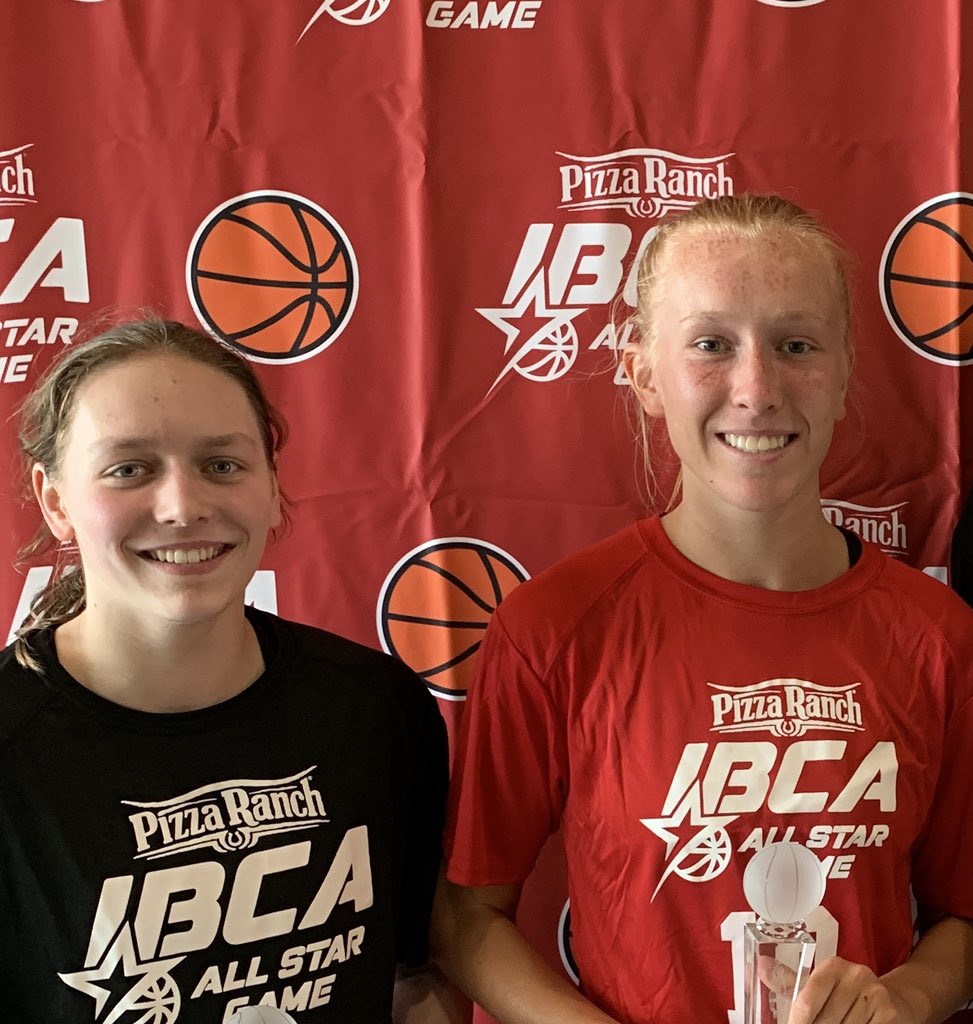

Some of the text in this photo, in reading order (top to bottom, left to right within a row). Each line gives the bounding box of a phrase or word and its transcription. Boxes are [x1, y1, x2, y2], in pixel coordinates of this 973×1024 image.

[425, 1, 542, 29] GAME
[560, 157, 734, 203] Pizza Ranch
[502, 223, 662, 307] IB
[0, 317, 79, 347] TAR
[588, 323, 635, 350] AL
[712, 686, 863, 727] Pizza Ranch
[661, 740, 898, 816] IBCA
[129, 777, 327, 852] Pizza Ranch
[806, 824, 889, 849] STAR
[84, 825, 374, 968] IBCA
[190, 925, 366, 1000] ALL STAR
